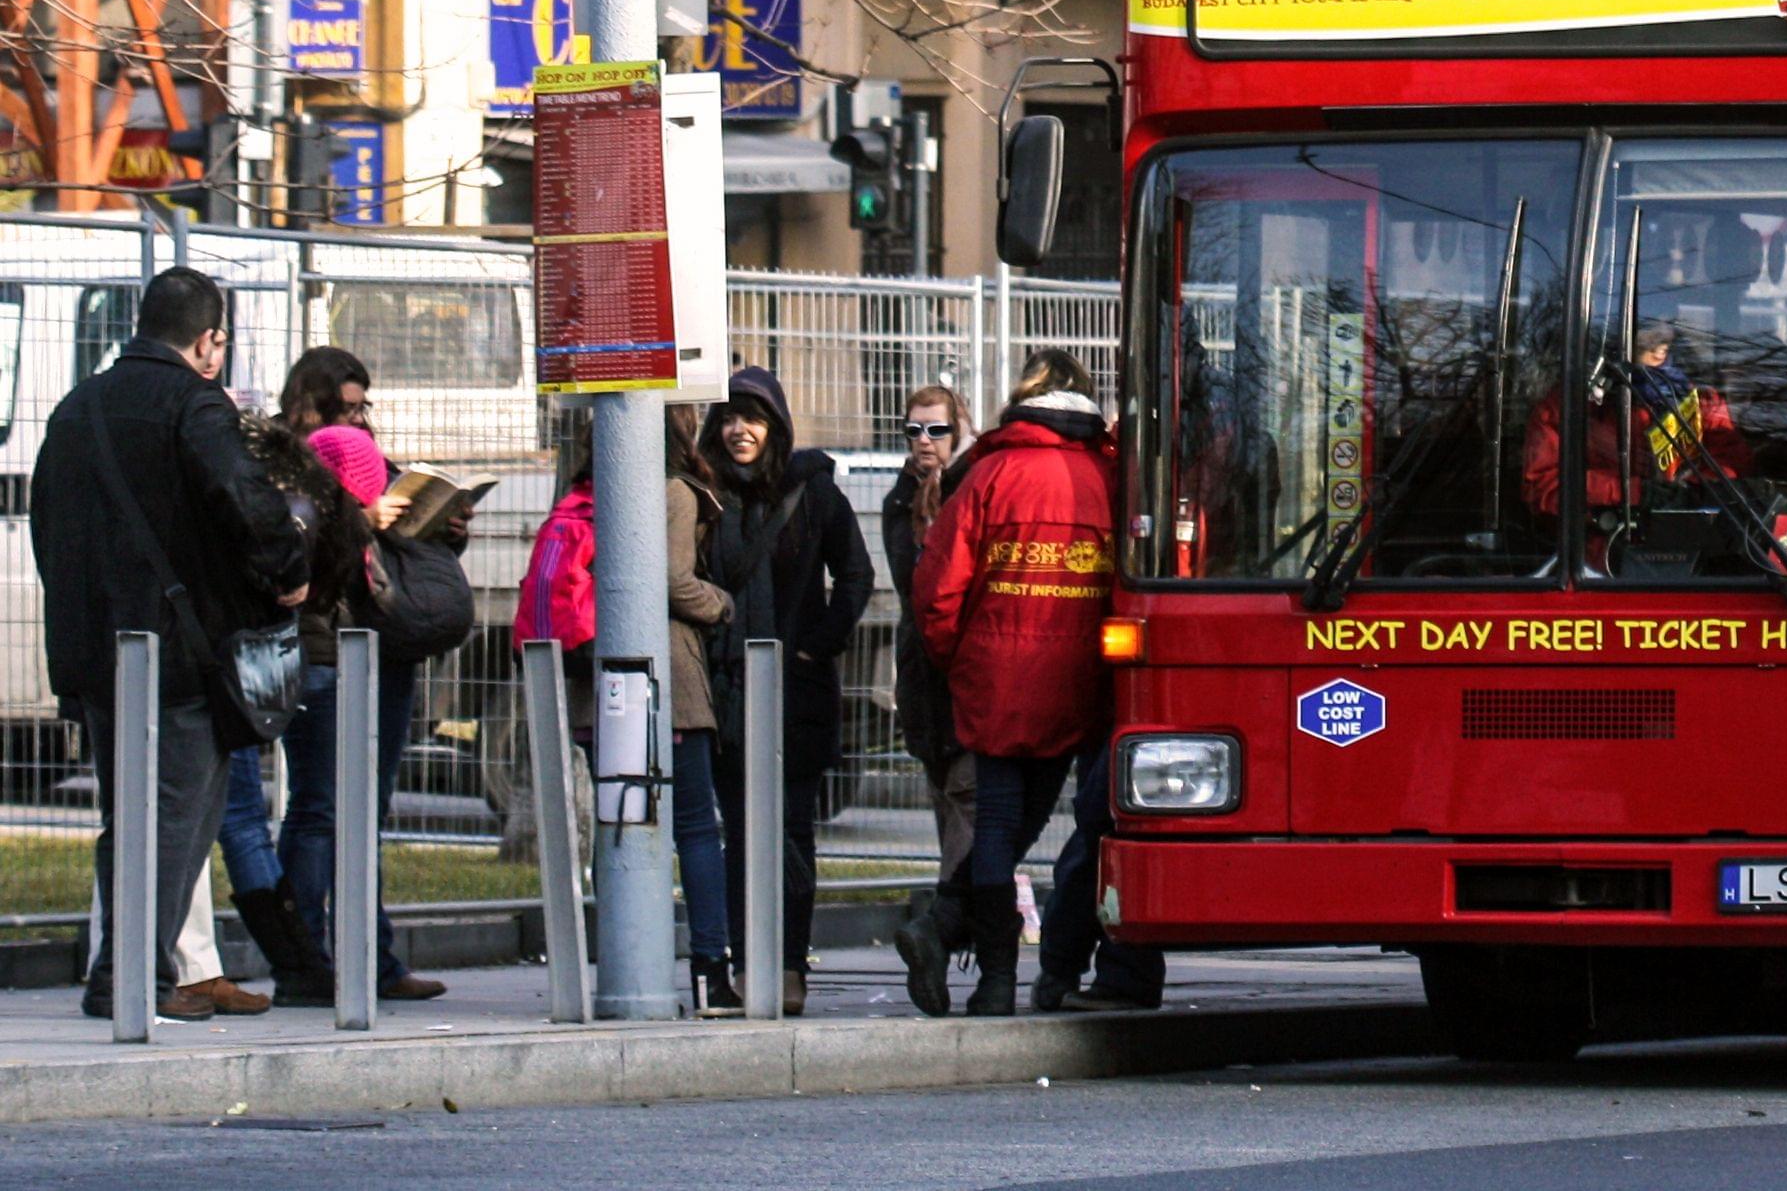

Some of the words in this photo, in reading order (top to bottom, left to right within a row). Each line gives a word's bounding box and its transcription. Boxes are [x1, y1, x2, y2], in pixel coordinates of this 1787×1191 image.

[565, 71, 586, 83] ON
[591, 69, 619, 81] HOP
[622, 67, 647, 80] OFF
[1306, 620, 1405, 650] NEXT
[1420, 620, 1493, 650] DAY
[1507, 620, 1603, 651] FREE!
[1615, 619, 1747, 650] TICKET
[1323, 691, 1361, 705] LOW
[1318, 706, 1365, 720] COST
[1322, 722, 1361, 735] LINE
[1725, 888, 1735, 900] H
